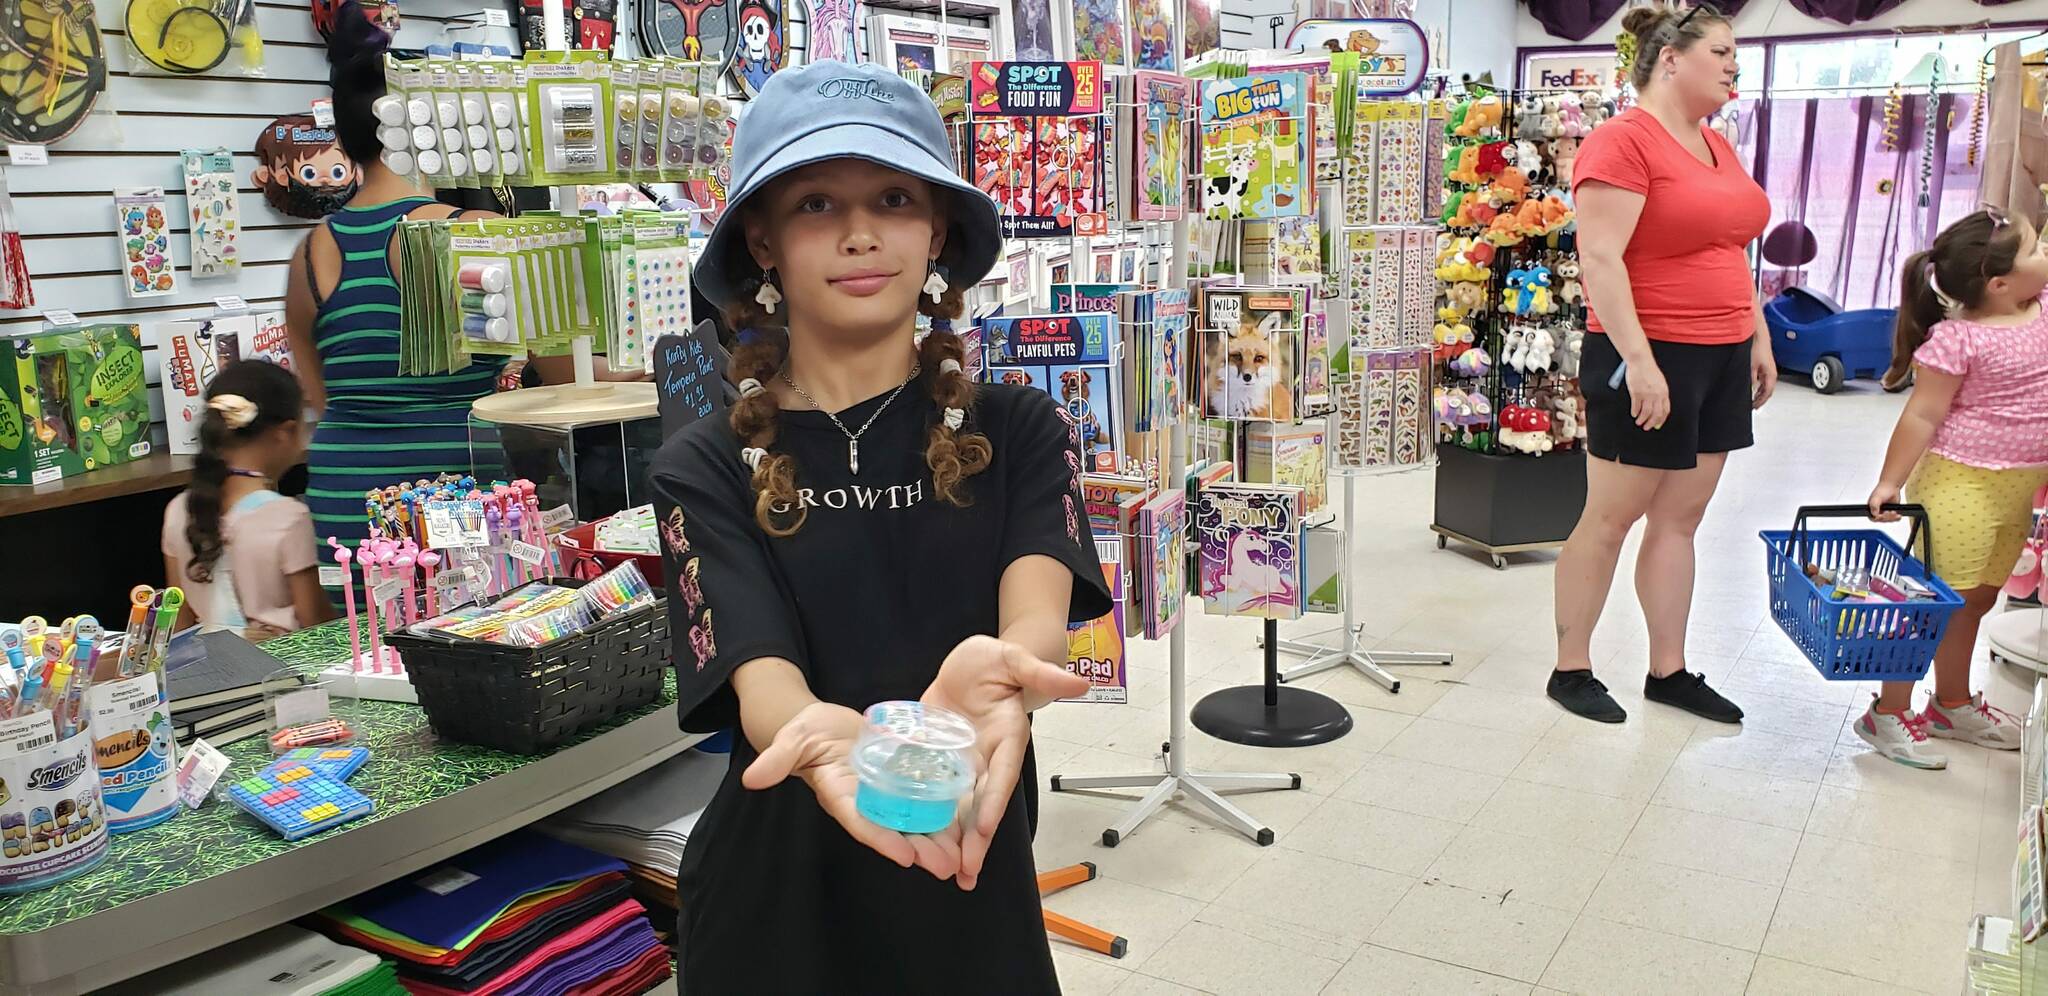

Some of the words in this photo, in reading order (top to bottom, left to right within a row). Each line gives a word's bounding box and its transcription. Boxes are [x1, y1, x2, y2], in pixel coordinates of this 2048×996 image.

[1007, 65, 1061, 83] SPOT
[1541, 68, 1598, 88] FedEx
[1023, 83, 1062, 91] Difference
[1076, 74, 1094, 95] 25
[1251, 81, 1279, 96] TIME
[1007, 91, 1036, 108] FOOD
[1039, 91, 1061, 107] FUN
[1216, 88, 1252, 119] BIG
[1252, 92, 1280, 109] FUN
[292, 128, 336, 142] Beardies
[1004, 220, 1021, 230] Spot
[1022, 221, 1040, 230] Them
[1041, 221, 1055, 230] All?
[1056, 292, 1118, 313] Pinces
[1213, 298, 1238, 311] WILD
[1020, 319, 1071, 336] SPOT
[1086, 325, 1102, 345] 25
[254, 327, 288, 349] HUMA
[1020, 335, 1034, 343] The
[1017, 344, 1054, 358] PLAYFUL
[1055, 343, 1076, 357] PETS
[96, 350, 134, 387] INSECT
[175, 336, 197, 393] HUMAN
[698, 398, 713, 418] each
[0, 403, 20, 438] SECT
[1085, 485, 1118, 503] TOY
[1221, 505, 1279, 528] PONY
[1078, 657, 1113, 678] Pad
[95, 729, 151, 758] mencils
[27, 752, 87, 790] Smencils
[0, 862, 41, 876] OCOLATE
[42, 848, 82, 868] CUPCAKE
